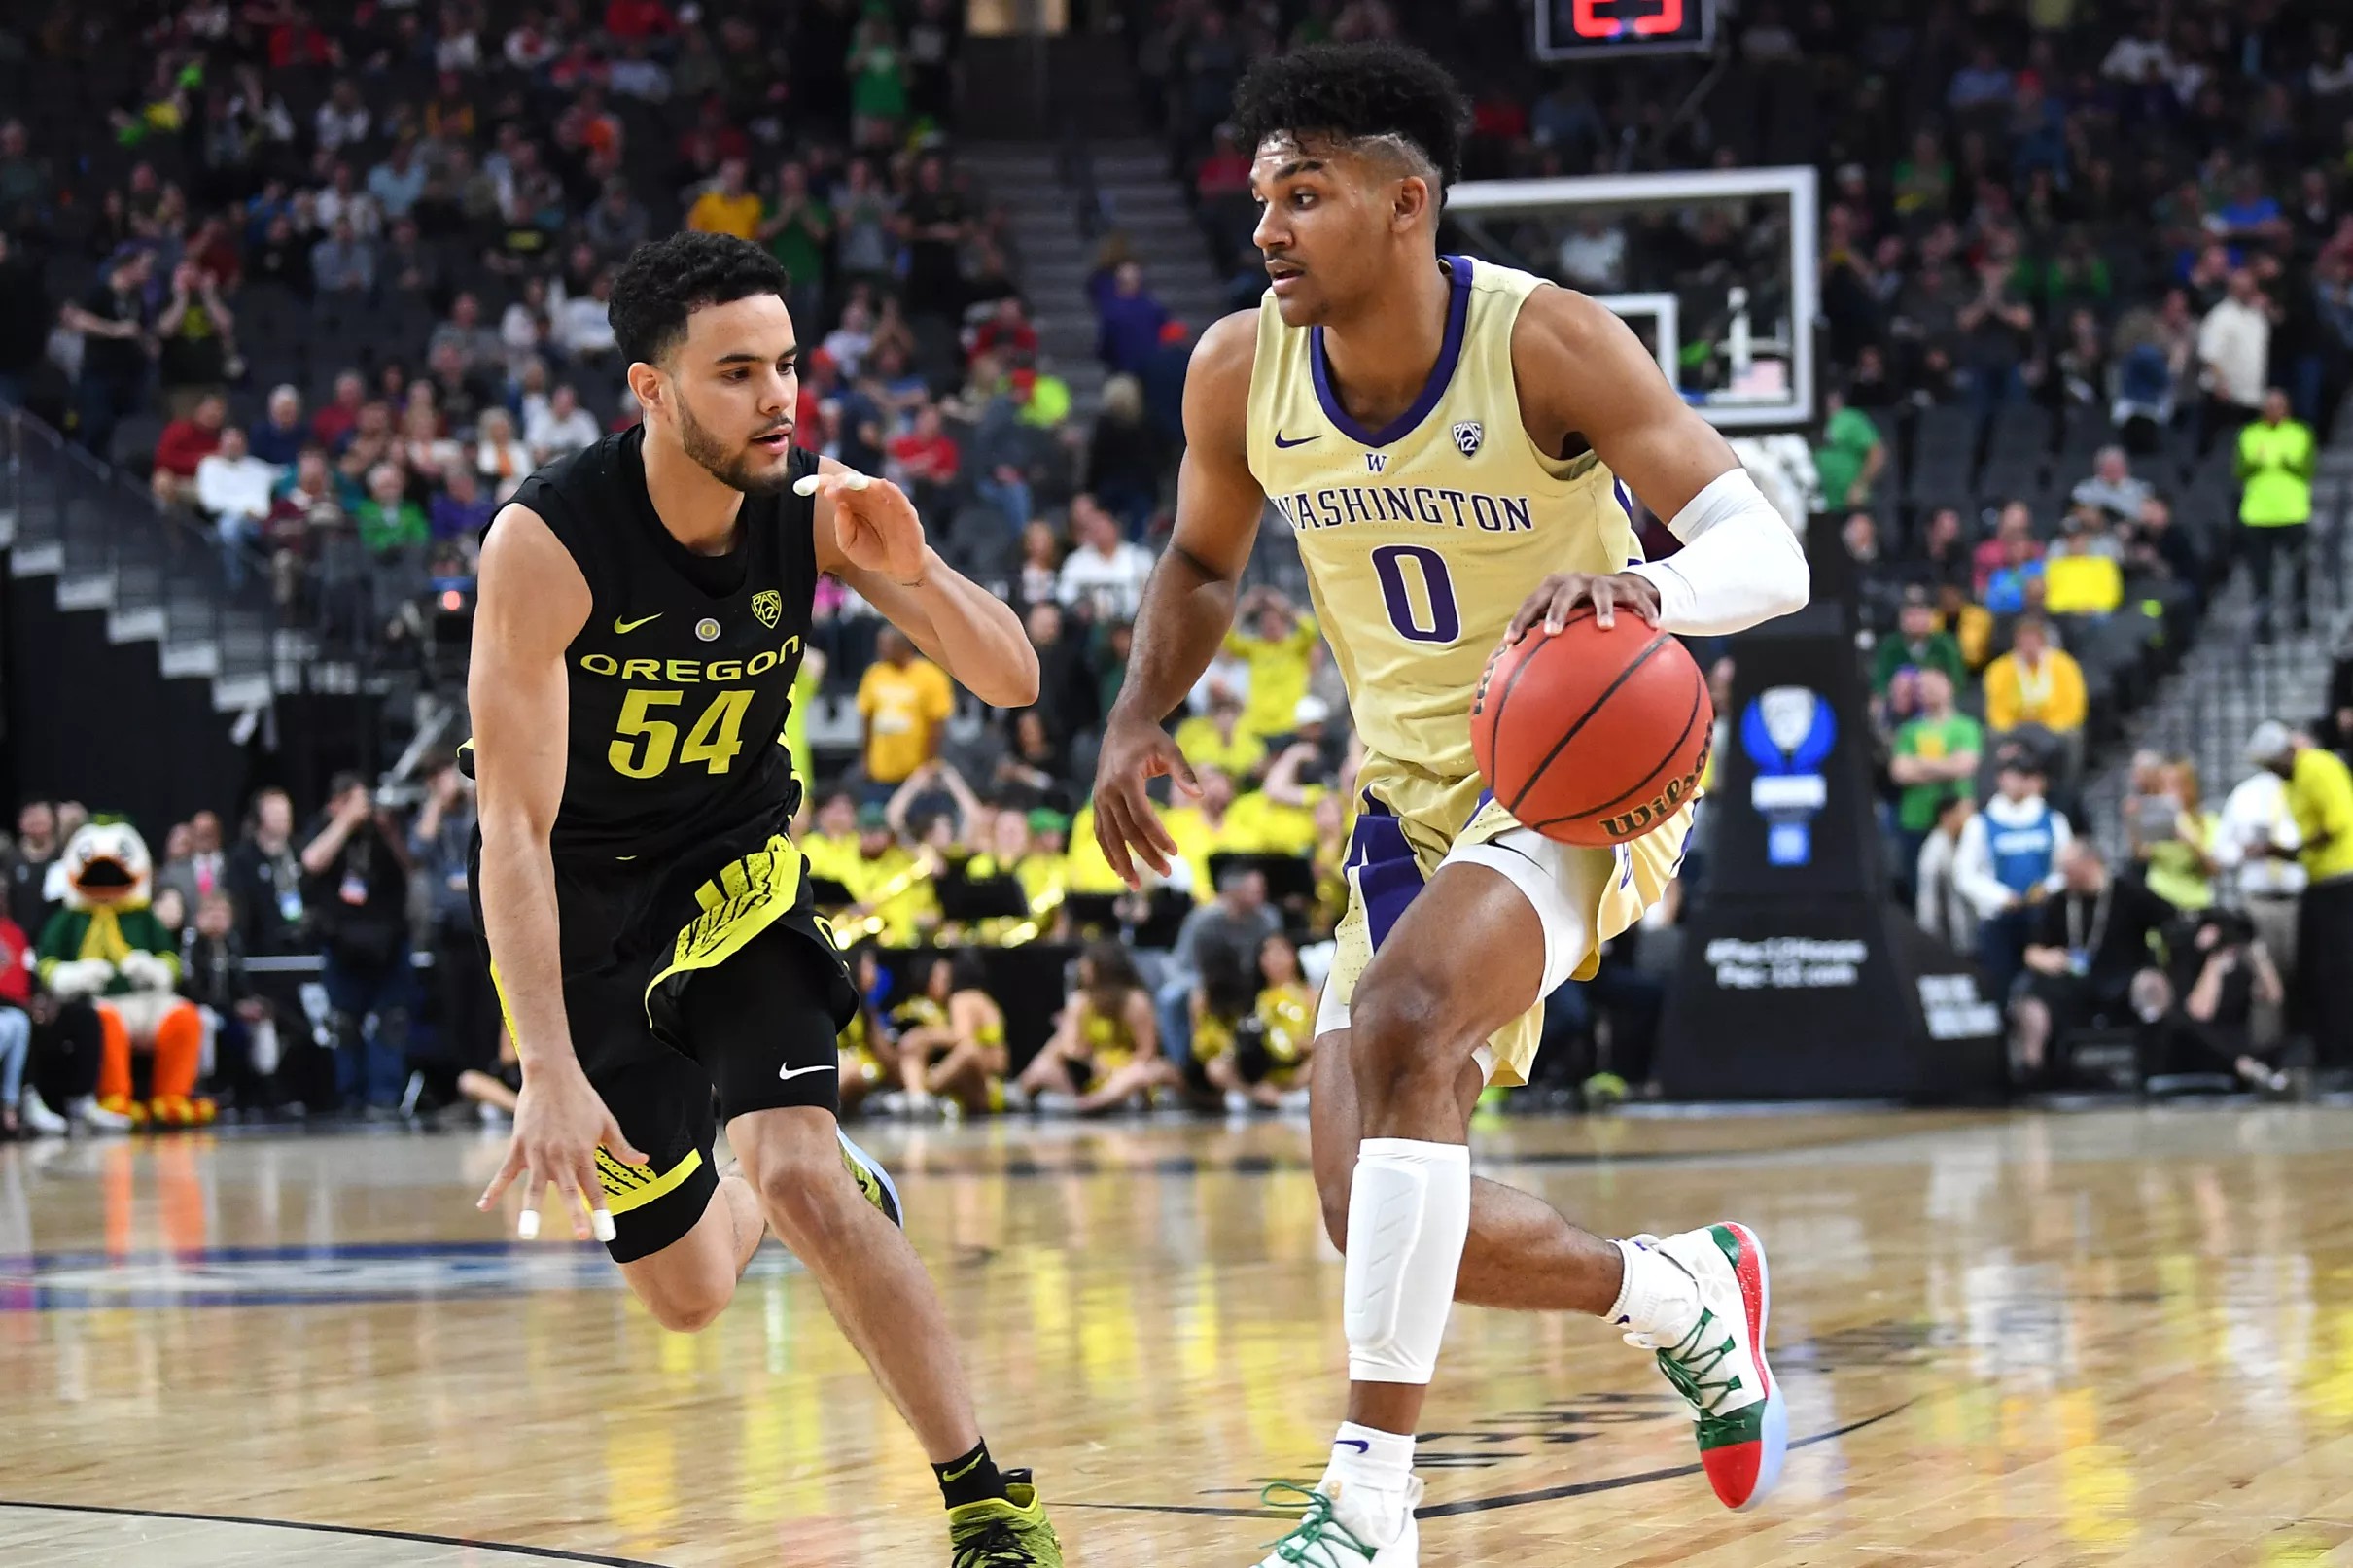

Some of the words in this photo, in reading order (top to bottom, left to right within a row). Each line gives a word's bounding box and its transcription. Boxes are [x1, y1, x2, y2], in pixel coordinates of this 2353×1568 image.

[1453, 421, 1482, 444] PAC
[1460, 436, 1476, 451] 12
[1364, 452, 1387, 473] W
[1268, 486, 1533, 531] WASHINGTON
[752, 593, 780, 615] PAC
[1371, 544, 1460, 644] 0
[761, 606, 776, 621] 12
[580, 635, 799, 683] OREGON
[608, 689, 755, 779] 54
